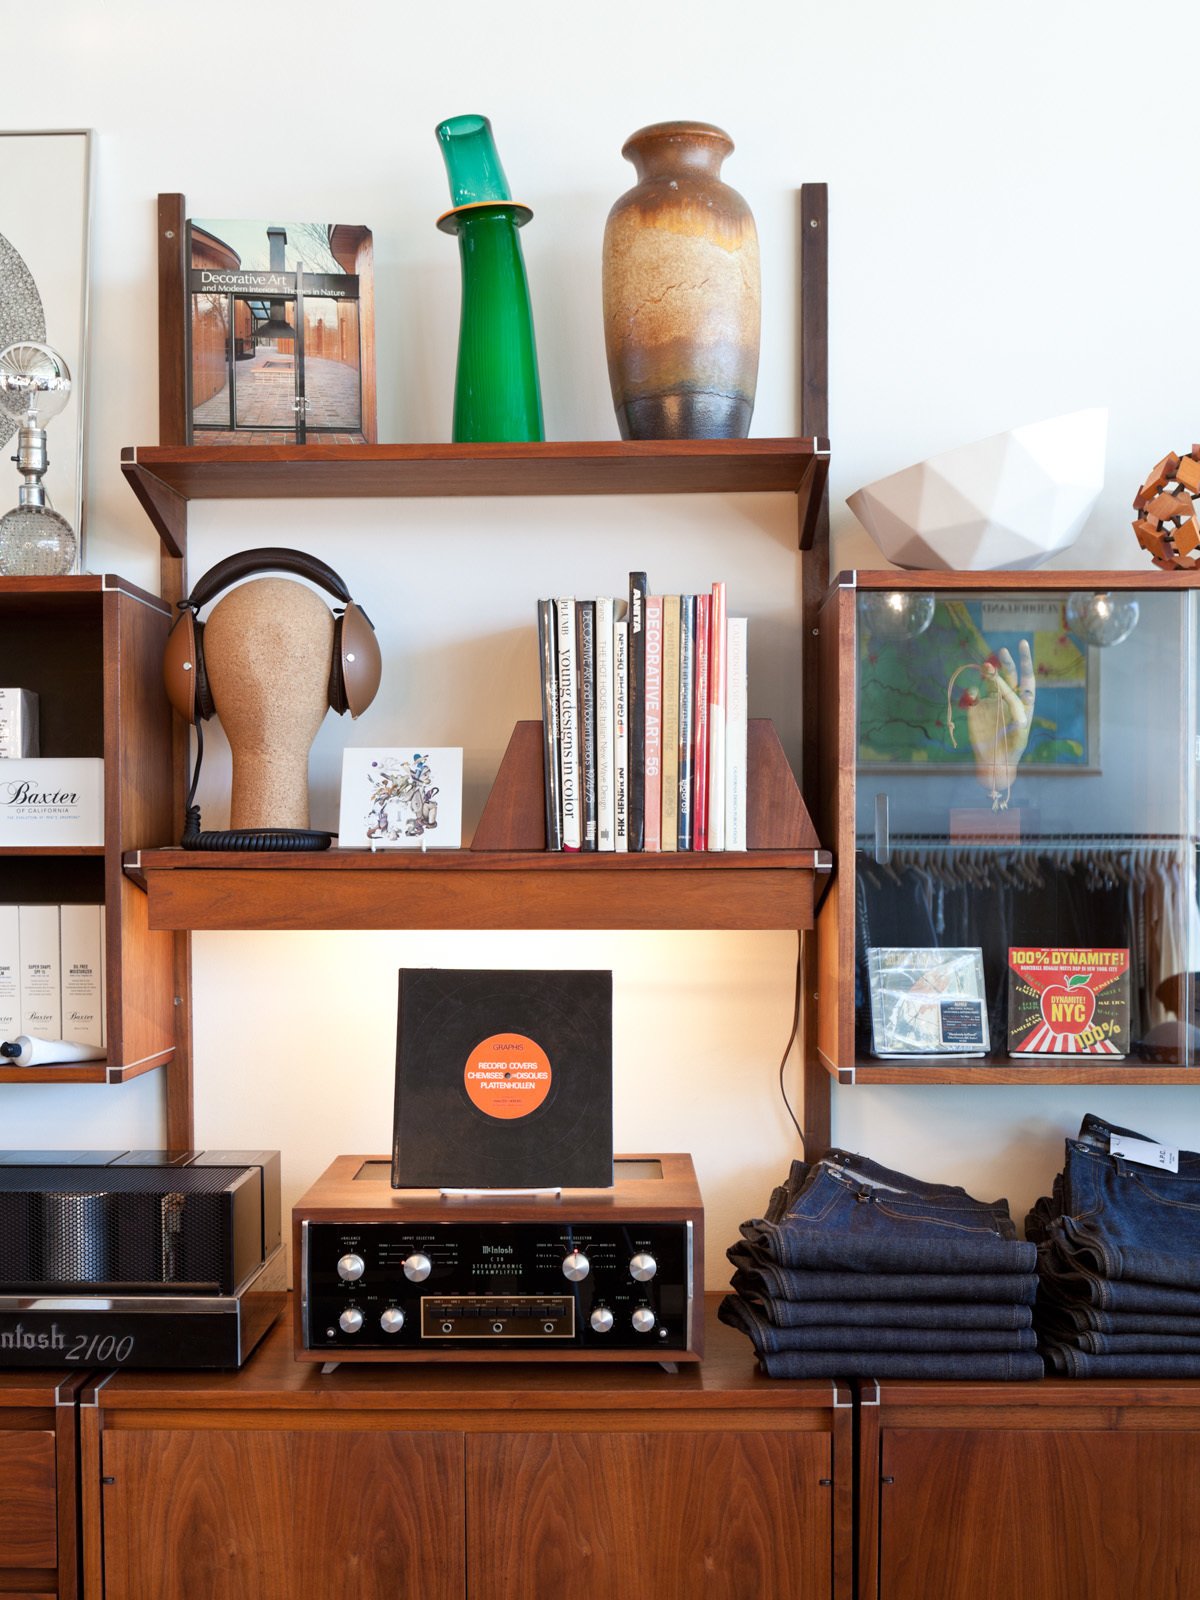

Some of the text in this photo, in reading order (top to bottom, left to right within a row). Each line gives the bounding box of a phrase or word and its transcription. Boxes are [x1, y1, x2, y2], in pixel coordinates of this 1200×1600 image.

[201, 272, 287, 286] Decorative Art
[218, 285, 248, 293] Modern
[249, 286, 278, 294] Interiors
[284, 287, 311, 296] Themes
[313, 288, 319, 296] in
[321, 289, 346, 297] Nature
[561, 601, 569, 635] PLUMB
[633, 588, 641, 634] ANITA
[583, 610, 592, 665] DECORATIVE
[666, 621, 676, 659] young
[599, 641, 607, 657] THE
[617, 634, 625, 671] DESIGN
[733, 624, 741, 676] CALIFORNIA
[584, 667, 592, 681] ART
[600, 659, 608, 678] HOT
[666, 660, 677, 701] designs
[584, 683, 592, 699] and
[646, 607, 660, 777] DECORATIVE ART 56
[585, 701, 593, 734] Modern
[600, 717, 608, 738] Italian
[558, 649, 579, 819] young designs in color
[665, 717, 677, 751] living
[600, 741, 608, 759] New
[600, 763, 608, 783] Wave
[4, 780, 80, 804] Baxter
[599, 785, 609, 810] Design
[1012, 951, 1125, 966] 100% DYNAMITE!
[1051, 996, 1086, 1004] DYNAMITE!
[28, 1011, 53, 1021] Baxter
[69, 1011, 94, 1021] Baxter
[1051, 1004, 1086, 1023] NYC
[1075, 1019, 1121, 1050] 100%
[468, 1072, 505, 1080] CHEMISES
[478, 1062, 538, 1070] RECORD COVERS
[483, 1245, 513, 1254] McIntosh
[65, 1335, 135, 1362] 2100
